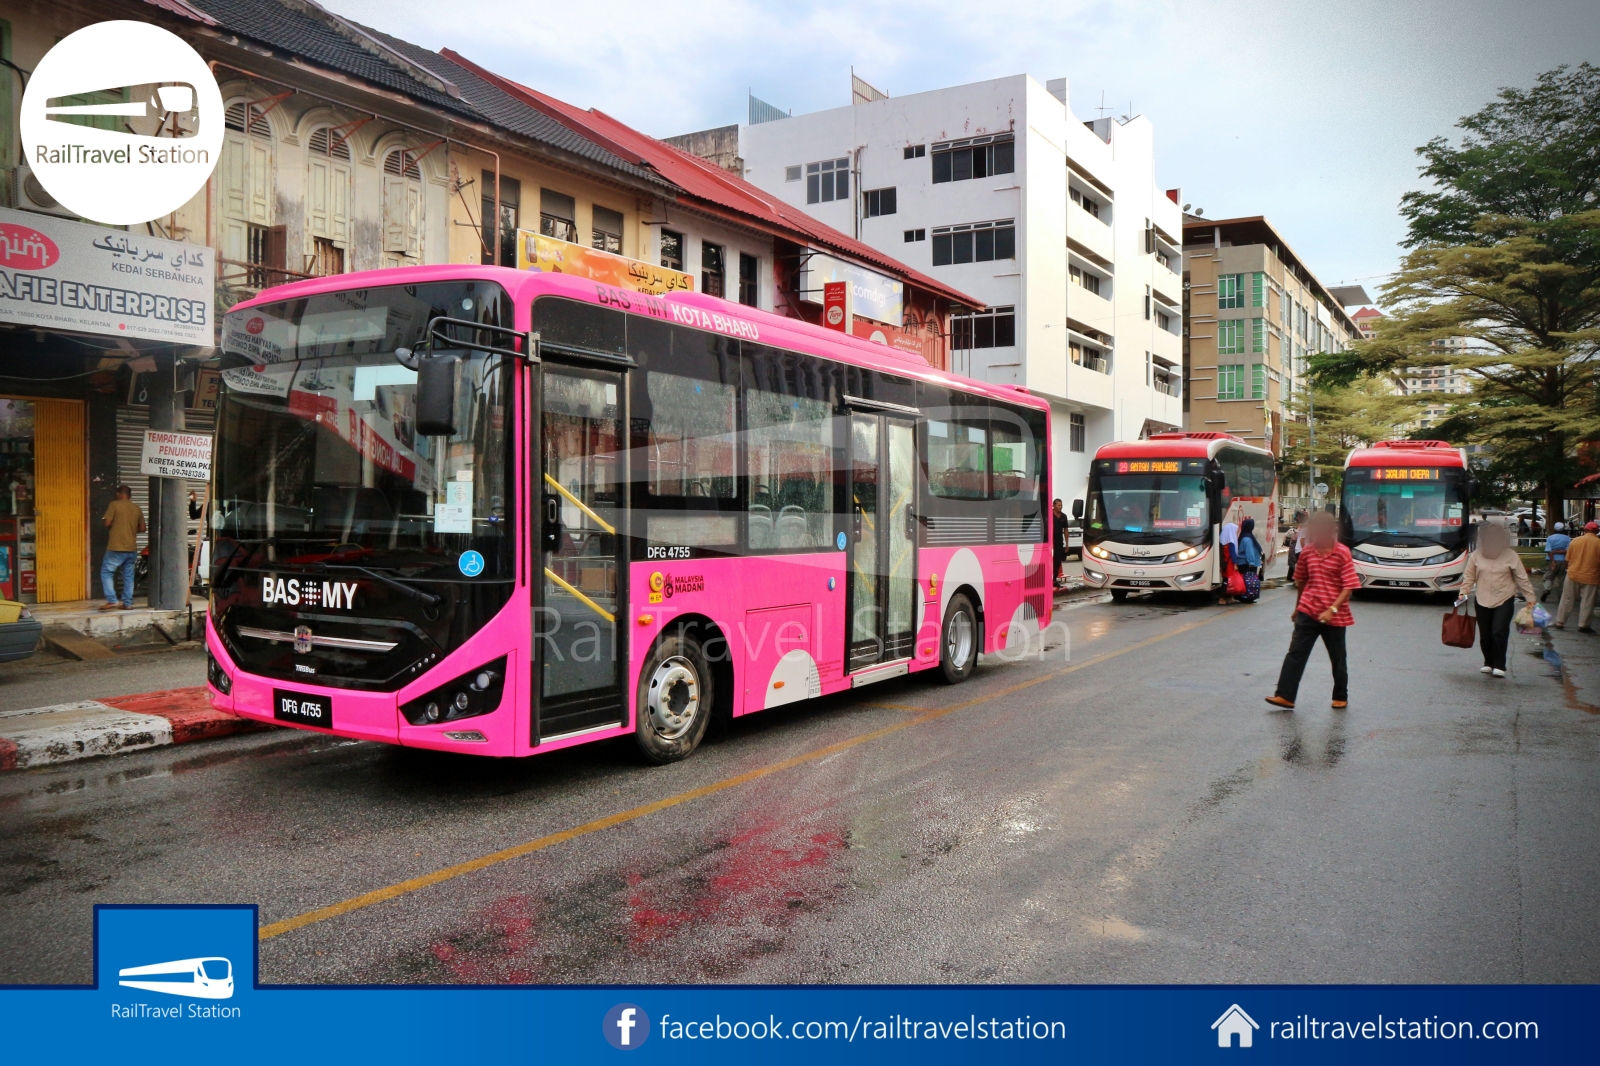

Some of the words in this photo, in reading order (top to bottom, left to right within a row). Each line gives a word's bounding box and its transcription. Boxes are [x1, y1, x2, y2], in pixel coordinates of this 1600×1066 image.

[111, 262, 143, 275] KEDAI
[145, 268, 204, 286] SERBANEKA
[61, 280, 207, 325] ENTERPRISE
[595, 285, 631, 310] BAS
[646, 297, 668, 319] MY
[670, 303, 713, 329] KOTA
[713, 314, 760, 340] BHARU
[148, 432, 178, 444] TEMPAT
[159, 445, 212, 460] PENUMPANG
[148, 457, 175, 467] KERETA
[176, 461, 197, 469] SEWA
[1118, 462, 1128, 472] 29
[1376, 469, 1382, 479] 4
[1410, 469, 1430, 479] CHEPA
[647, 547, 666, 558] DFG
[668, 547, 690, 558] 4755
[675, 575, 704, 584] MALAYSIA
[262, 577, 300, 605] BAS
[322, 582, 358, 609] MY
[675, 583, 704, 593] MADANI
[282, 698, 298, 714] DFG
[301, 701, 322, 717] 4755
